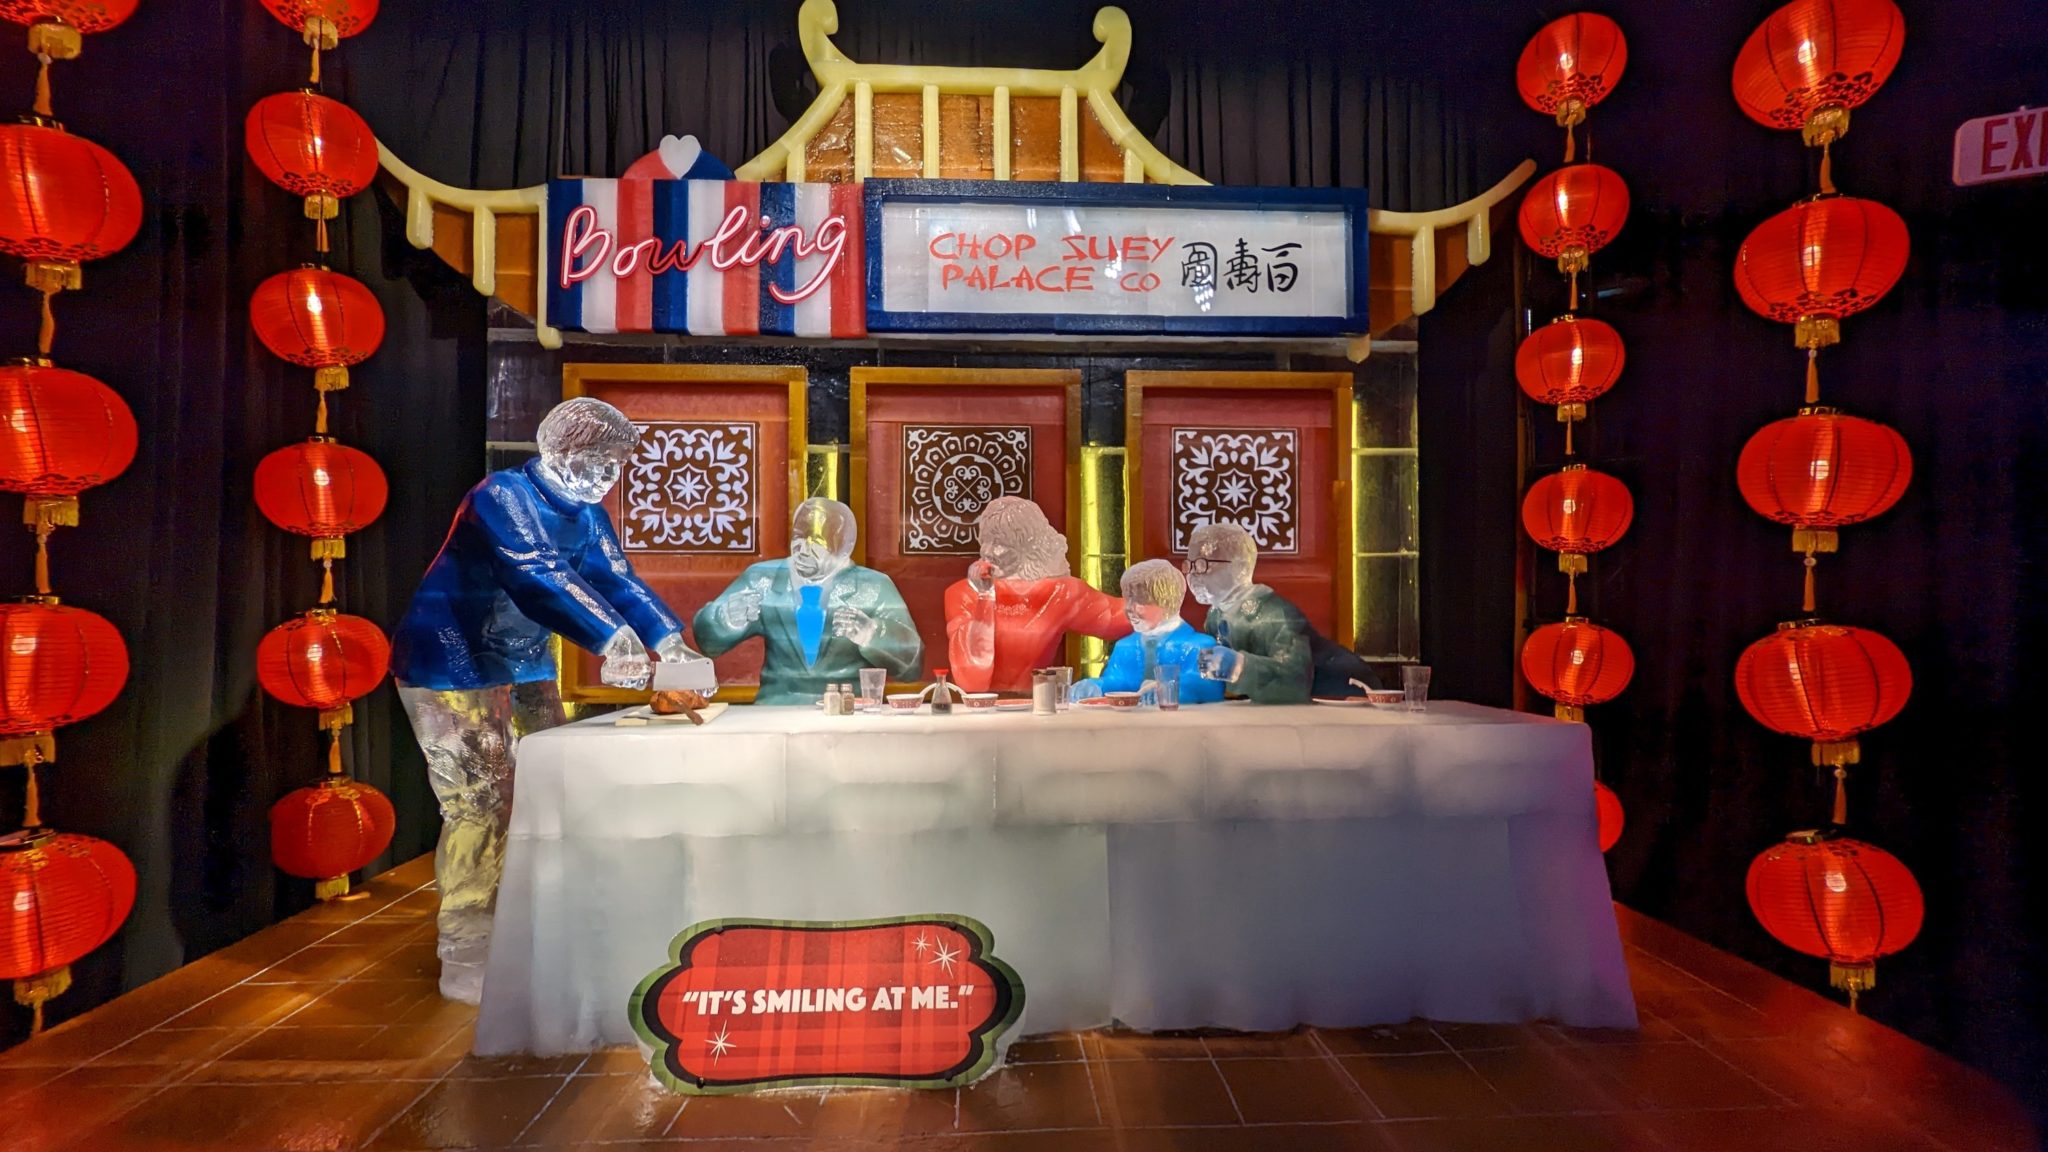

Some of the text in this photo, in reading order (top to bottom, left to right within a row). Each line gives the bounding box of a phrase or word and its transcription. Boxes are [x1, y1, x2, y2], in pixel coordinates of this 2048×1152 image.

[560, 205, 848, 304] Bowling
[929, 232, 1176, 263] CHOP SUEY
[942, 264, 1161, 293] PALACE CO
[751, 985, 867, 1015] SMILING
[871, 985, 906, 1012] AT
